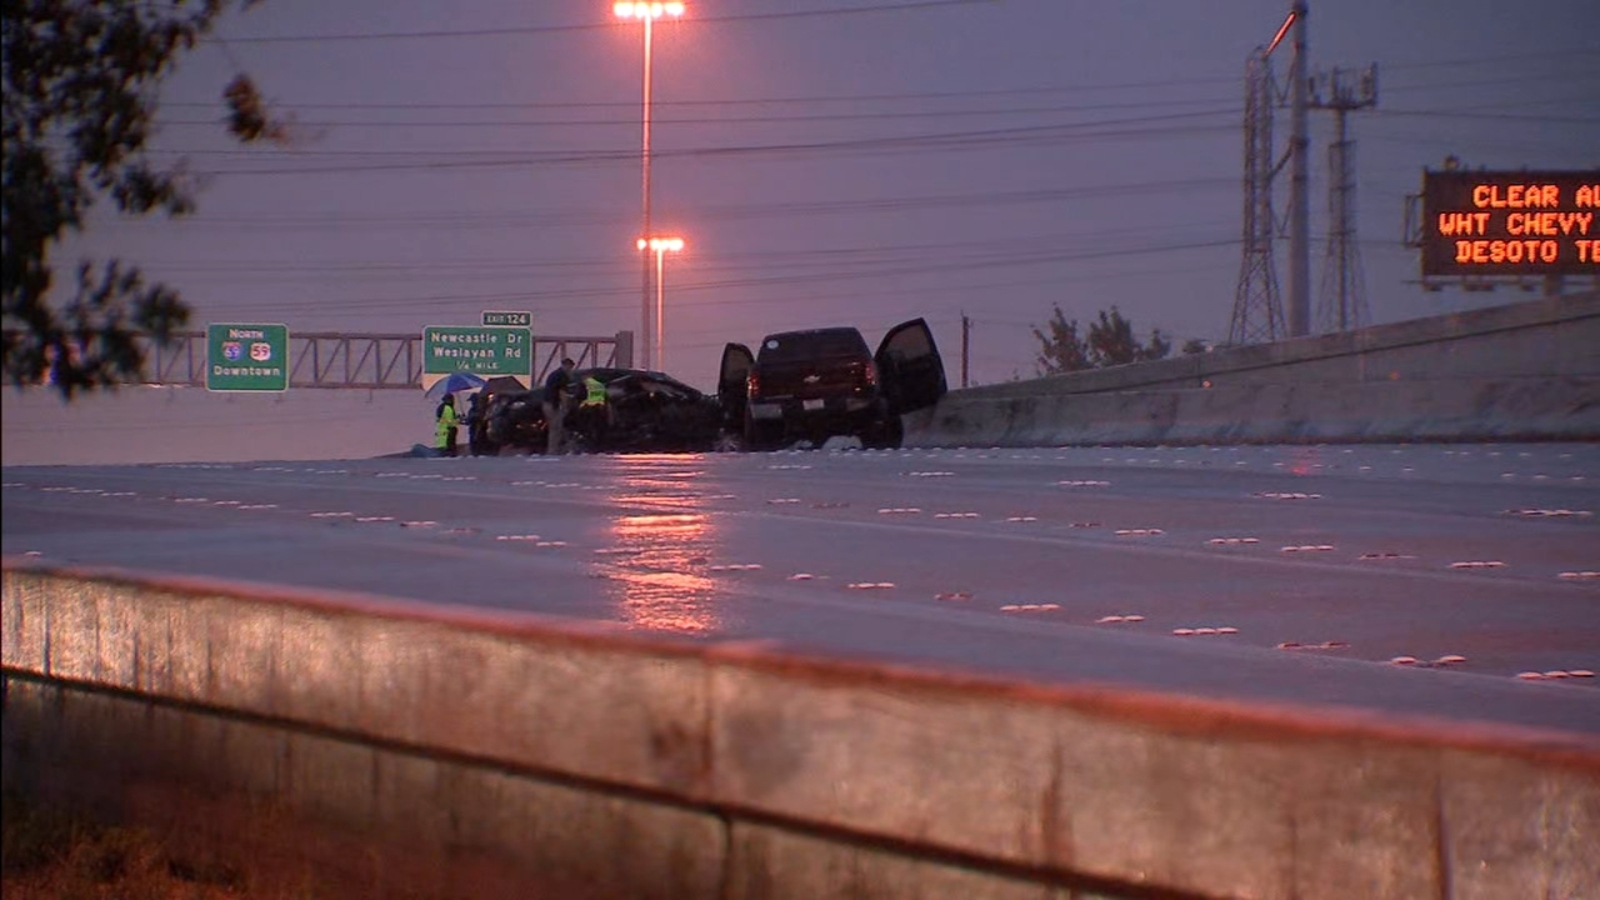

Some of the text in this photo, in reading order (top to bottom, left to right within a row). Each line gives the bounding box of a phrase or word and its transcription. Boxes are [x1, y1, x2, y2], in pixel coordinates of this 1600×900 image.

[1473, 184, 1560, 208] CLEAR
[1438, 212, 1593, 236] WHT CHEVY
[1455, 239, 1558, 264] DESOTO
[507, 314, 526, 324] 124
[430, 331, 523, 343] Newcastle Dr
[433, 347, 521, 359] Weslayan Rd
[213, 365, 281, 376] Downtown
